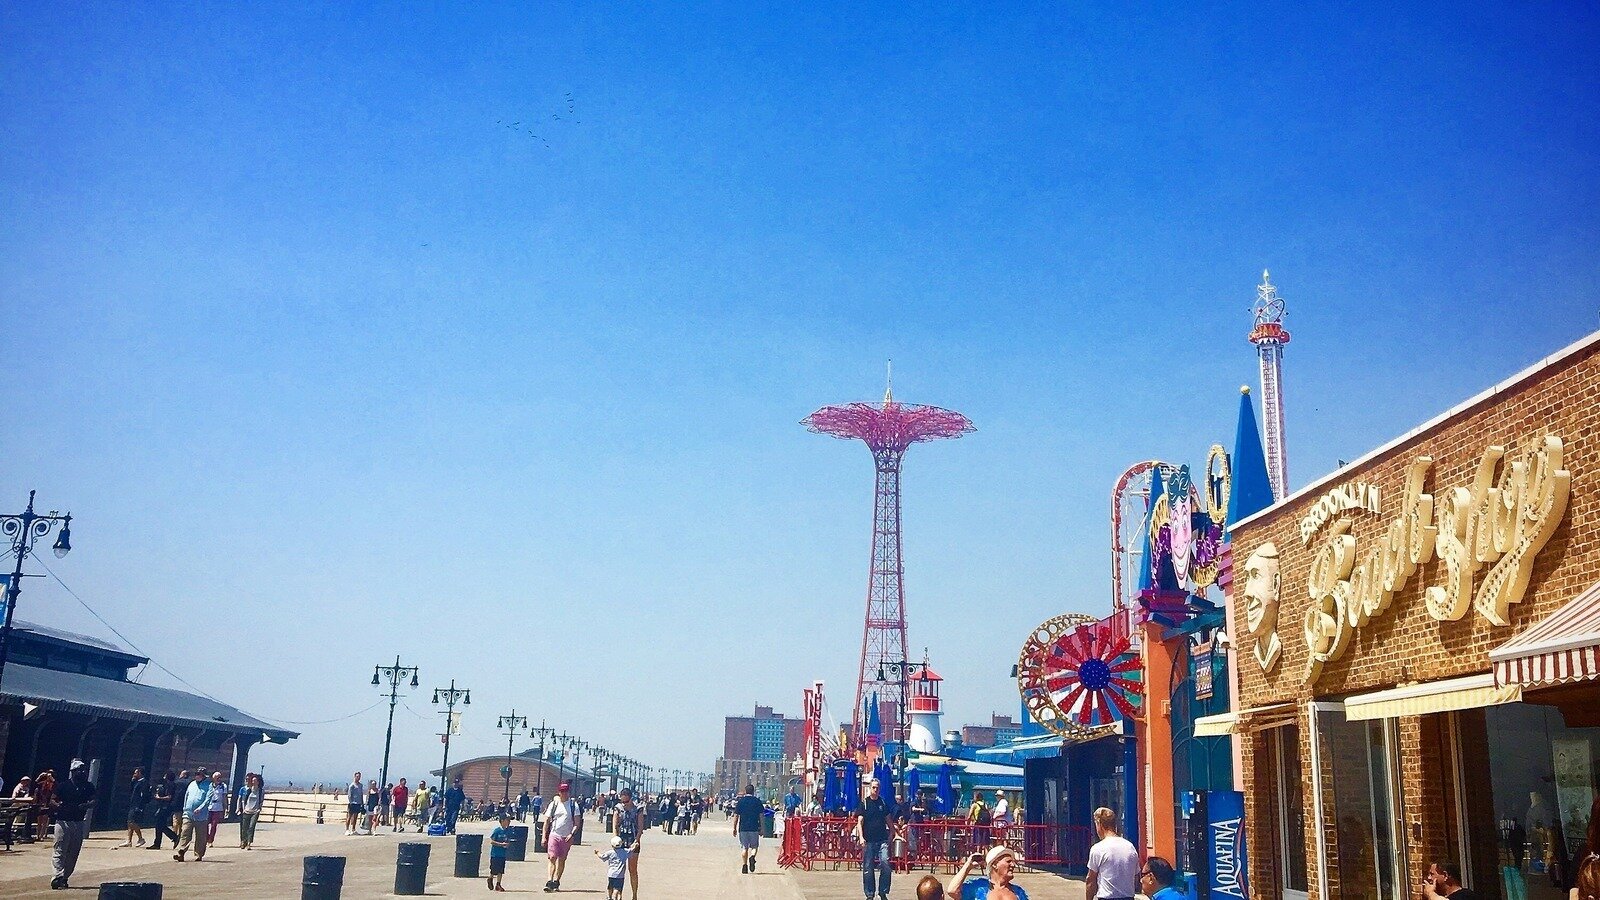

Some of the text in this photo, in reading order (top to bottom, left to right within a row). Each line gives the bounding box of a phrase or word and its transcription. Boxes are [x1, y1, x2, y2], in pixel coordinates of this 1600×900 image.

[1300, 481, 1382, 546] BROOKLYN
[1425, 435, 1571, 627] Shop
[1209, 816, 1245, 899] AQUAFINA
